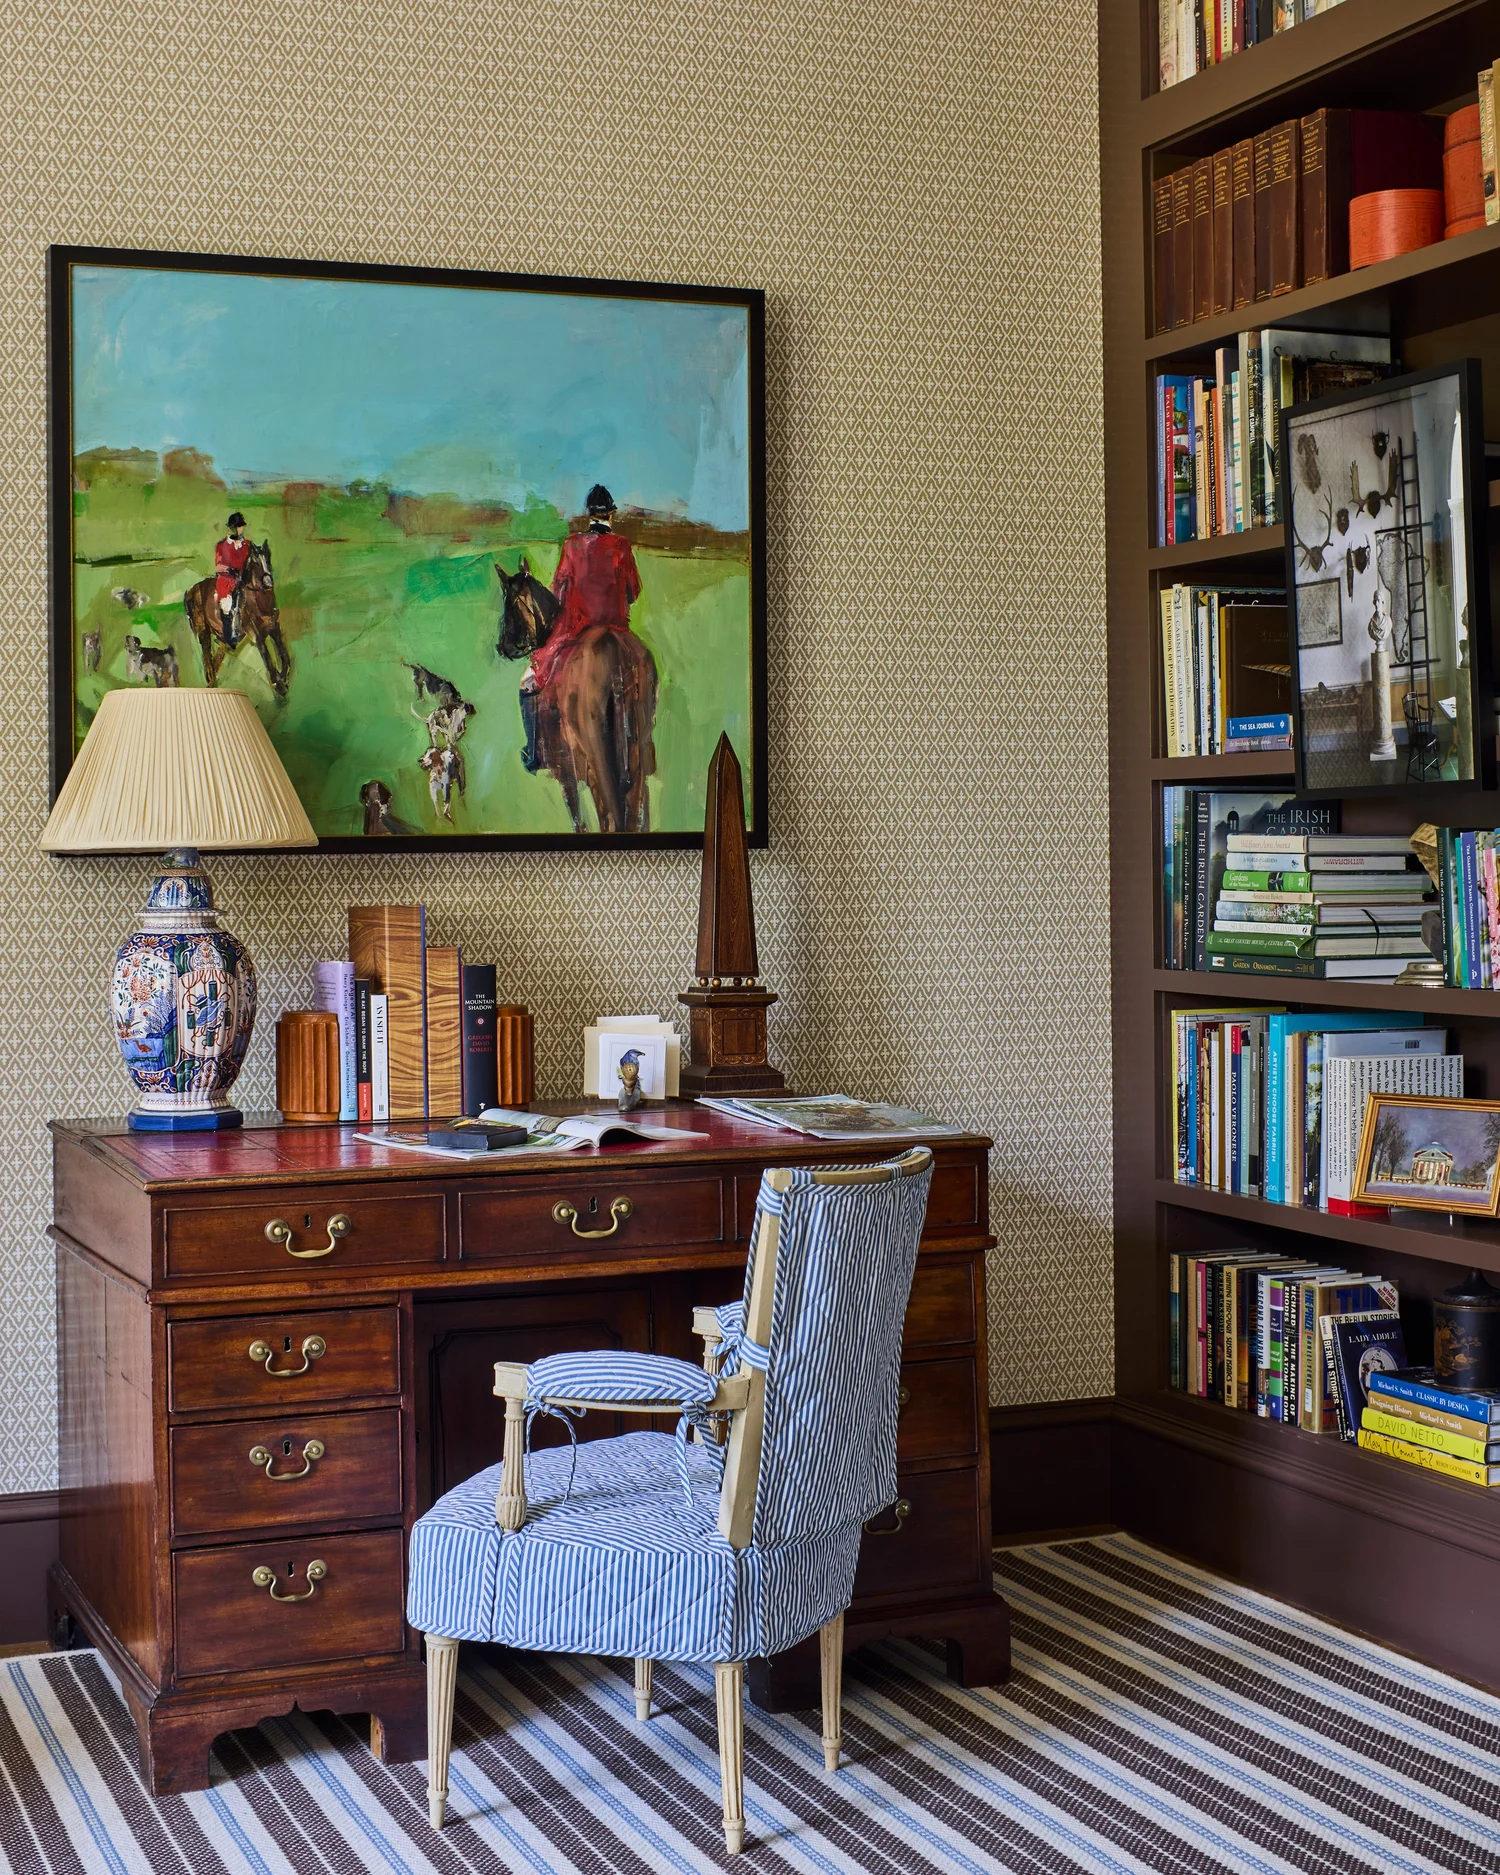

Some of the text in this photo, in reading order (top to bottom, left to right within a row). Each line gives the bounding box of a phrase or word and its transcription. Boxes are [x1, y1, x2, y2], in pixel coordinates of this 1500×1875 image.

[1266, 810, 1330, 823] THE IRISH
[1266, 826, 1330, 834] GARDEN
[1229, 873, 1248, 882] Gardens
[1232, 960, 1250, 969] GARDEN
[1253, 962, 1277, 971] ORNAMENT
[350, 1000, 356, 1010] of
[376, 1005, 384, 1014] AS
[350, 1011, 356, 1019] AI
[377, 1036, 383, 1045] IT
[1243, 1127, 1246, 1135] OF
[1305, 1289, 1314, 1332] THE PRIZE
[1344, 1315, 1369, 1324] BERLIN
[1349, 1332, 1398, 1343] LADY ADDLE
[1323, 1340, 1335, 1369] BERLIN
[1328, 1370, 1339, 1405] STORIES
[1377, 1380, 1394, 1391] Michael
[1399, 1387, 1413, 1397] Smith
[1416, 1392, 1439, 1404] CLASSIC
[1448, 1399, 1470, 1412] DESIGN
[1290, 1404, 1295, 1416] OF
[1370, 1397, 1463, 1429] Designing History Michael S. Smith
[1378, 1416, 1444, 1446] DAVID NETTO
[1362, 1431, 1434, 1466] May I Come In?
[1449, 1463, 1472, 1476] GOODMAN
